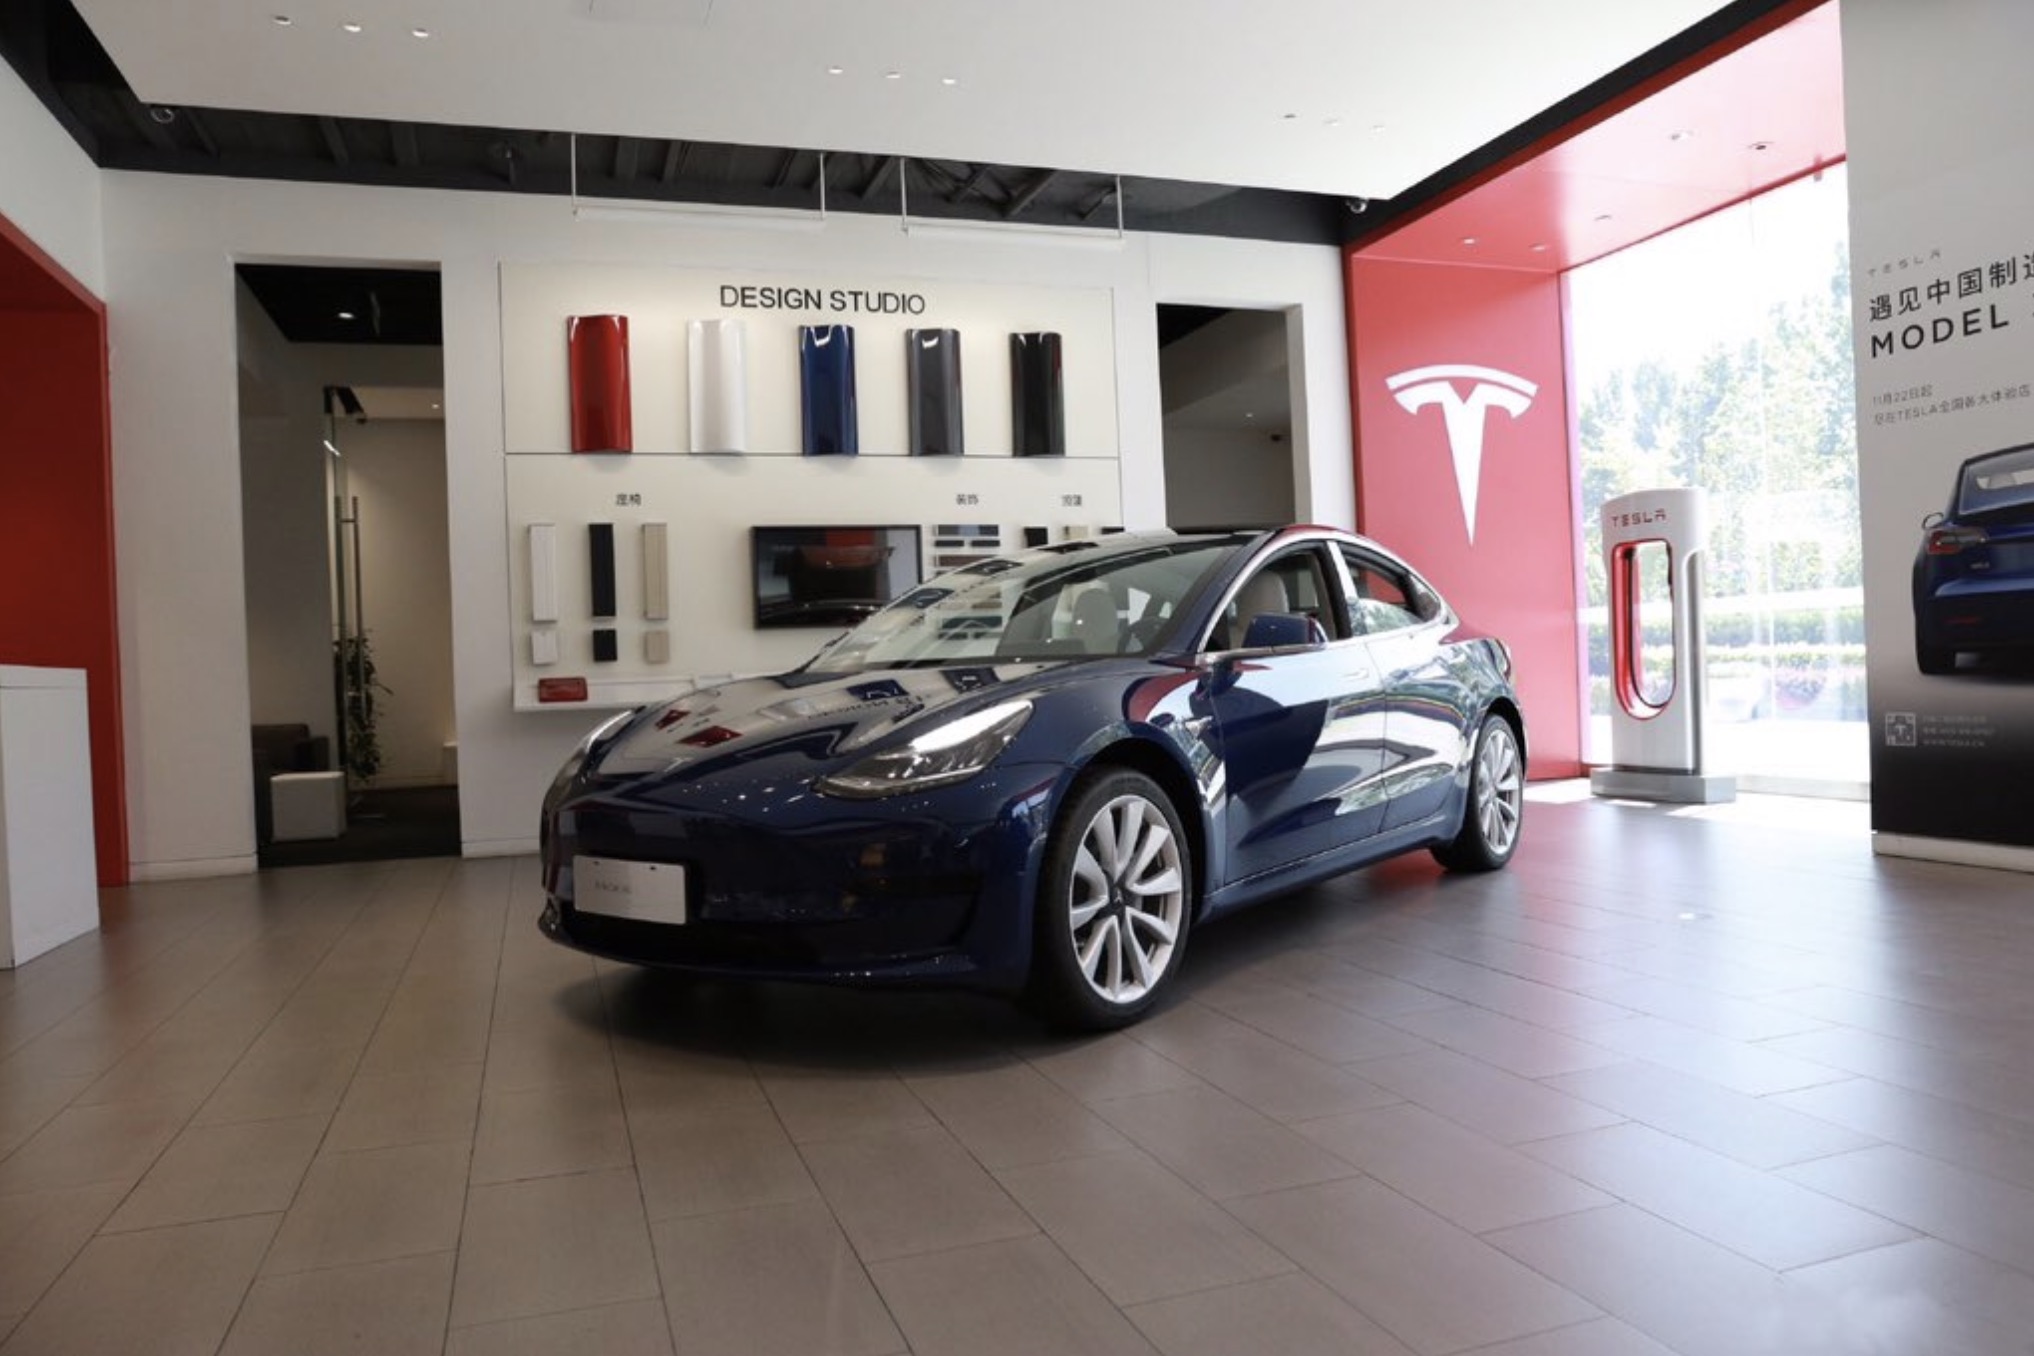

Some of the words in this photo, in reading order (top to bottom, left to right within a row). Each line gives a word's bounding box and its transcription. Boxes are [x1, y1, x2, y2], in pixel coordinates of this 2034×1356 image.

[1866, 248, 1941, 278] TESLA
[720, 285, 822, 310] DESIGN
[829, 290, 926, 315] STUDIO
[1871, 303, 2010, 359] MODEL
[1611, 508, 1667, 528] TESLA
